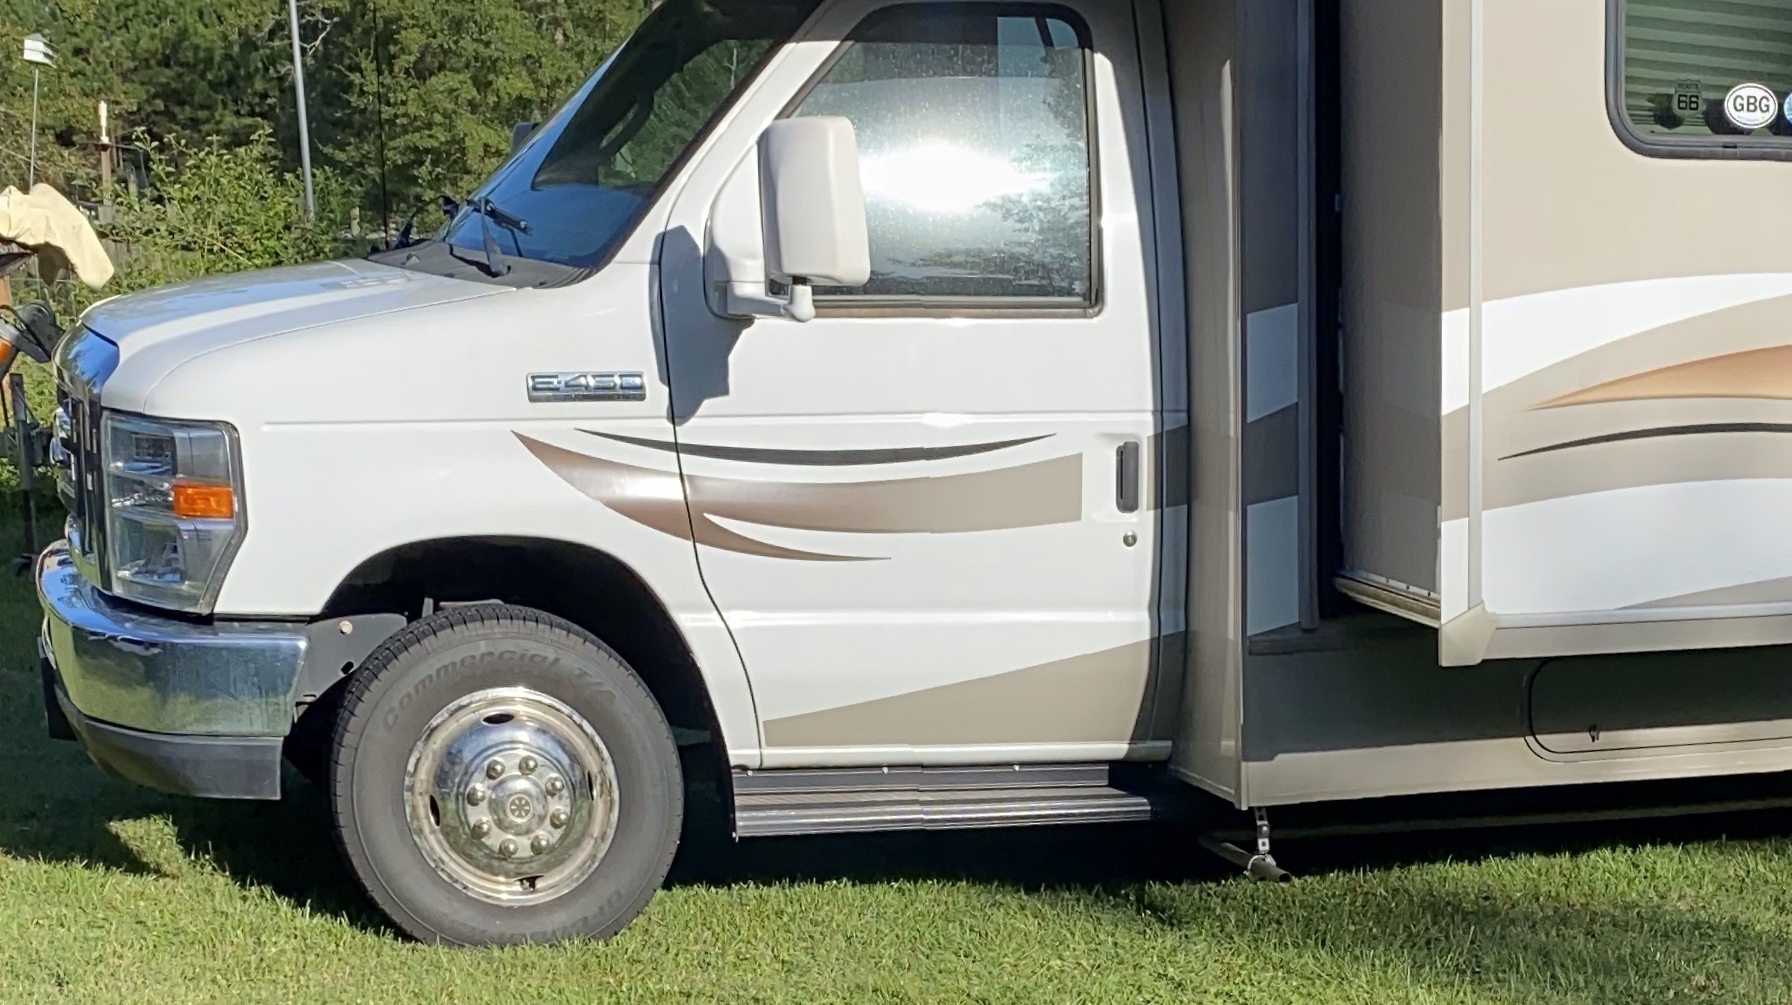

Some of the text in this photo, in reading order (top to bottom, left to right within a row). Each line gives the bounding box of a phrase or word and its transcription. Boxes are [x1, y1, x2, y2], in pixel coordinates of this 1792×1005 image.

[1677, 94, 1700, 111] 66
[1733, 95, 1770, 113] GBG
[382, 649, 561, 732] Commercial
